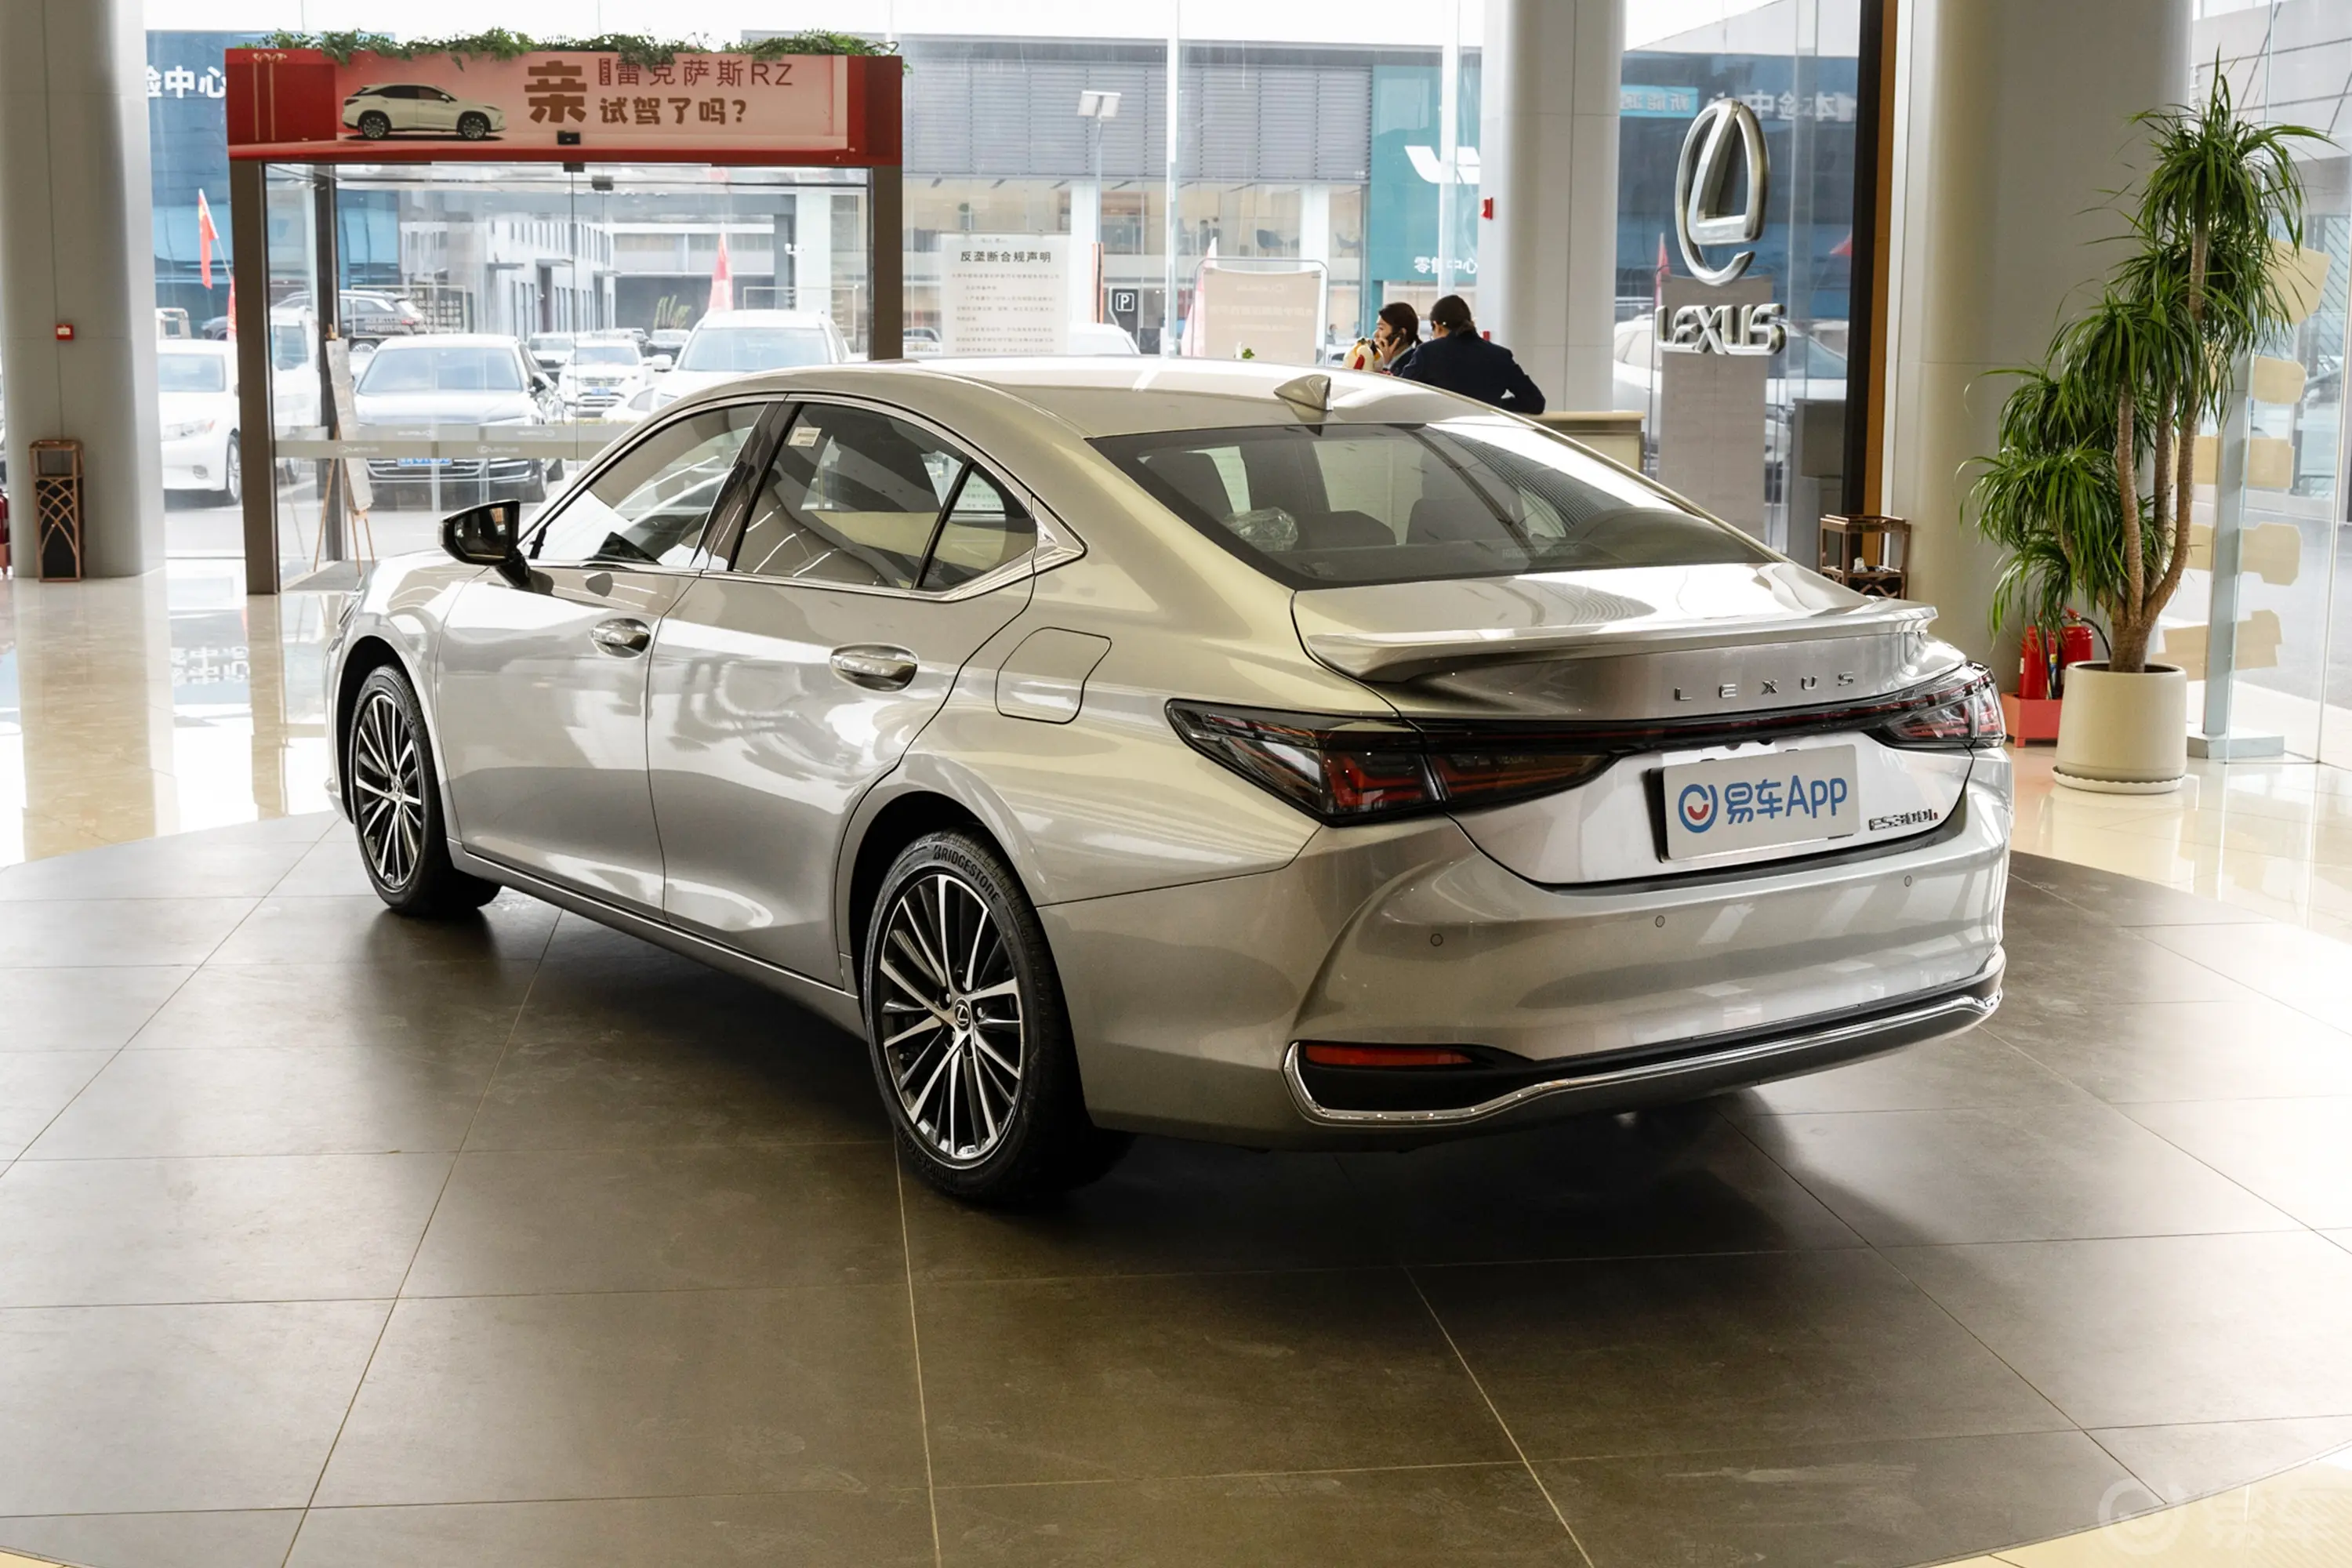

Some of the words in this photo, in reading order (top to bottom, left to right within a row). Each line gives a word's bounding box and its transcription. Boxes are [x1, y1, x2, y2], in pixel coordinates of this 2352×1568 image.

[524, 60, 587, 123] 亲
[615, 59, 793, 86] 雷克萨斯RZ
[960, 251, 1051, 263] 反垄断合规声明
[1655, 303, 1787, 356] LEXUS
[1675, 671, 1854, 701] LEXUS
[933, 844, 1000, 904] BRIDGESTONE
